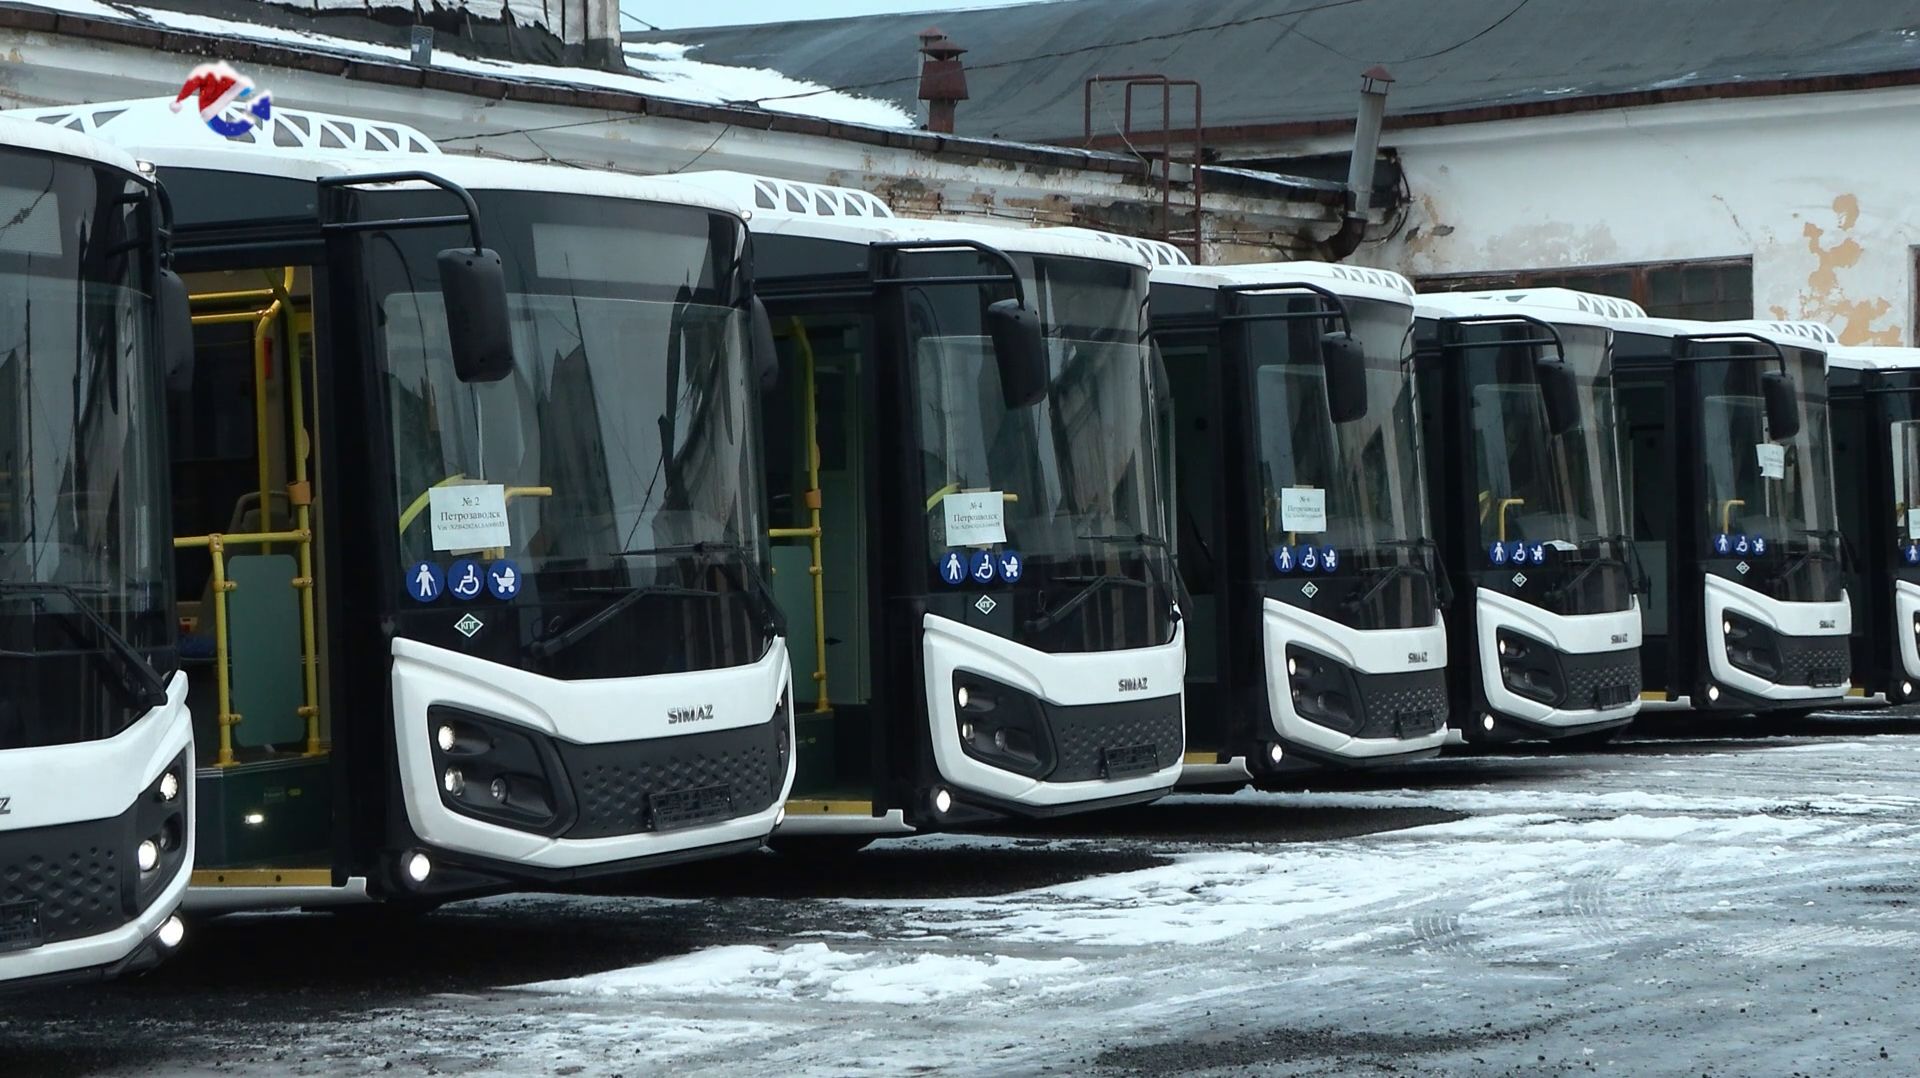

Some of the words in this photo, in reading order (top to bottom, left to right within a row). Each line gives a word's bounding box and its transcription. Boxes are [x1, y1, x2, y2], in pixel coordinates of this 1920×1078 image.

[474, 496, 480, 506] 2
[440, 511, 501, 522] Петрозаводск
[667, 704, 714, 724] SIMAZ
